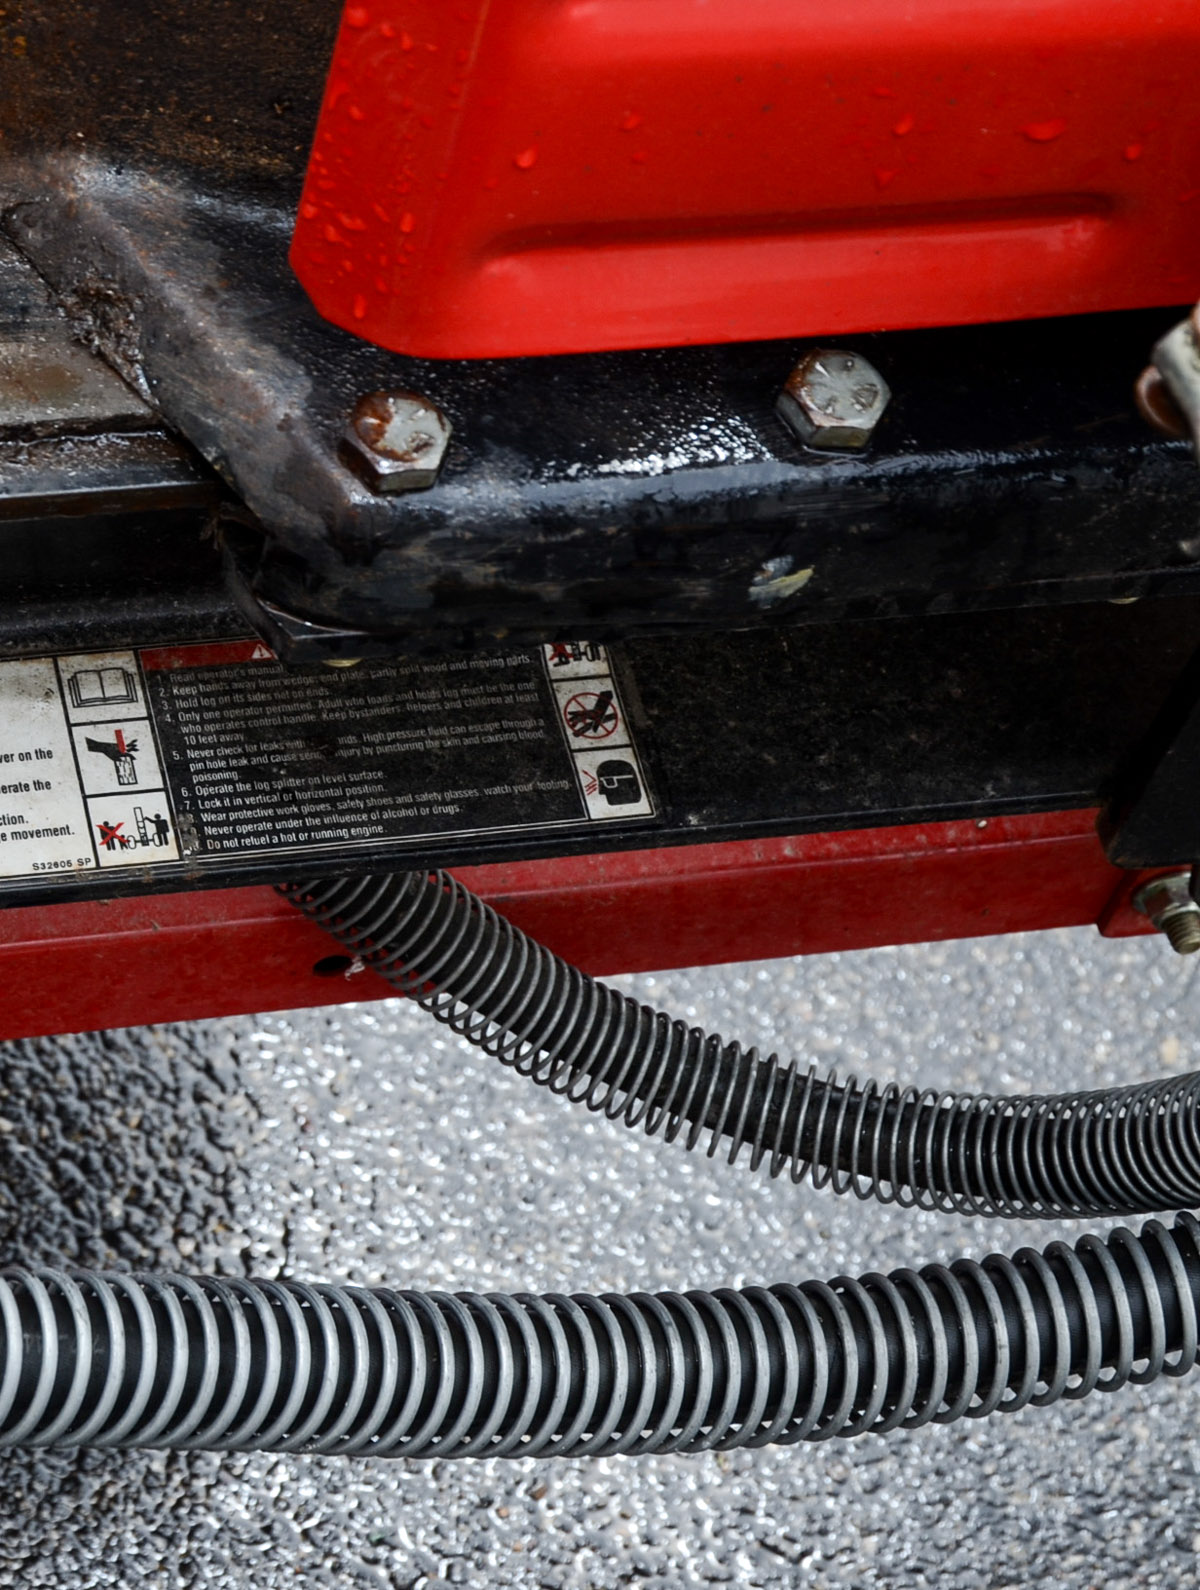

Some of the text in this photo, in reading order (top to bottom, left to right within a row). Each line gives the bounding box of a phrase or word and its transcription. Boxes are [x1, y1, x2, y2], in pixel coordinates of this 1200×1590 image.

[18, 751, 32, 761] on
[34, 748, 53, 760] the
[32, 779, 51, 791] the
[181, 787, 192, 797] 6.
[195, 784, 234, 796] Operate
[235, 782, 251, 791] the
[253, 781, 270, 791] log
[271, 778, 305, 789] splitter
[308, 776, 320, 785] on
[321, 772, 346, 783] level
[10, 824, 76, 840] movement.
[203, 825, 233, 835] Never
[235, 821, 273, 834] operate
[275, 818, 302, 829] under
[304, 816, 321, 826] the
[206, 825, 388, 849] Do not refuel a hot or running engine.
[32, 857, 92, 871] S32605 SP
